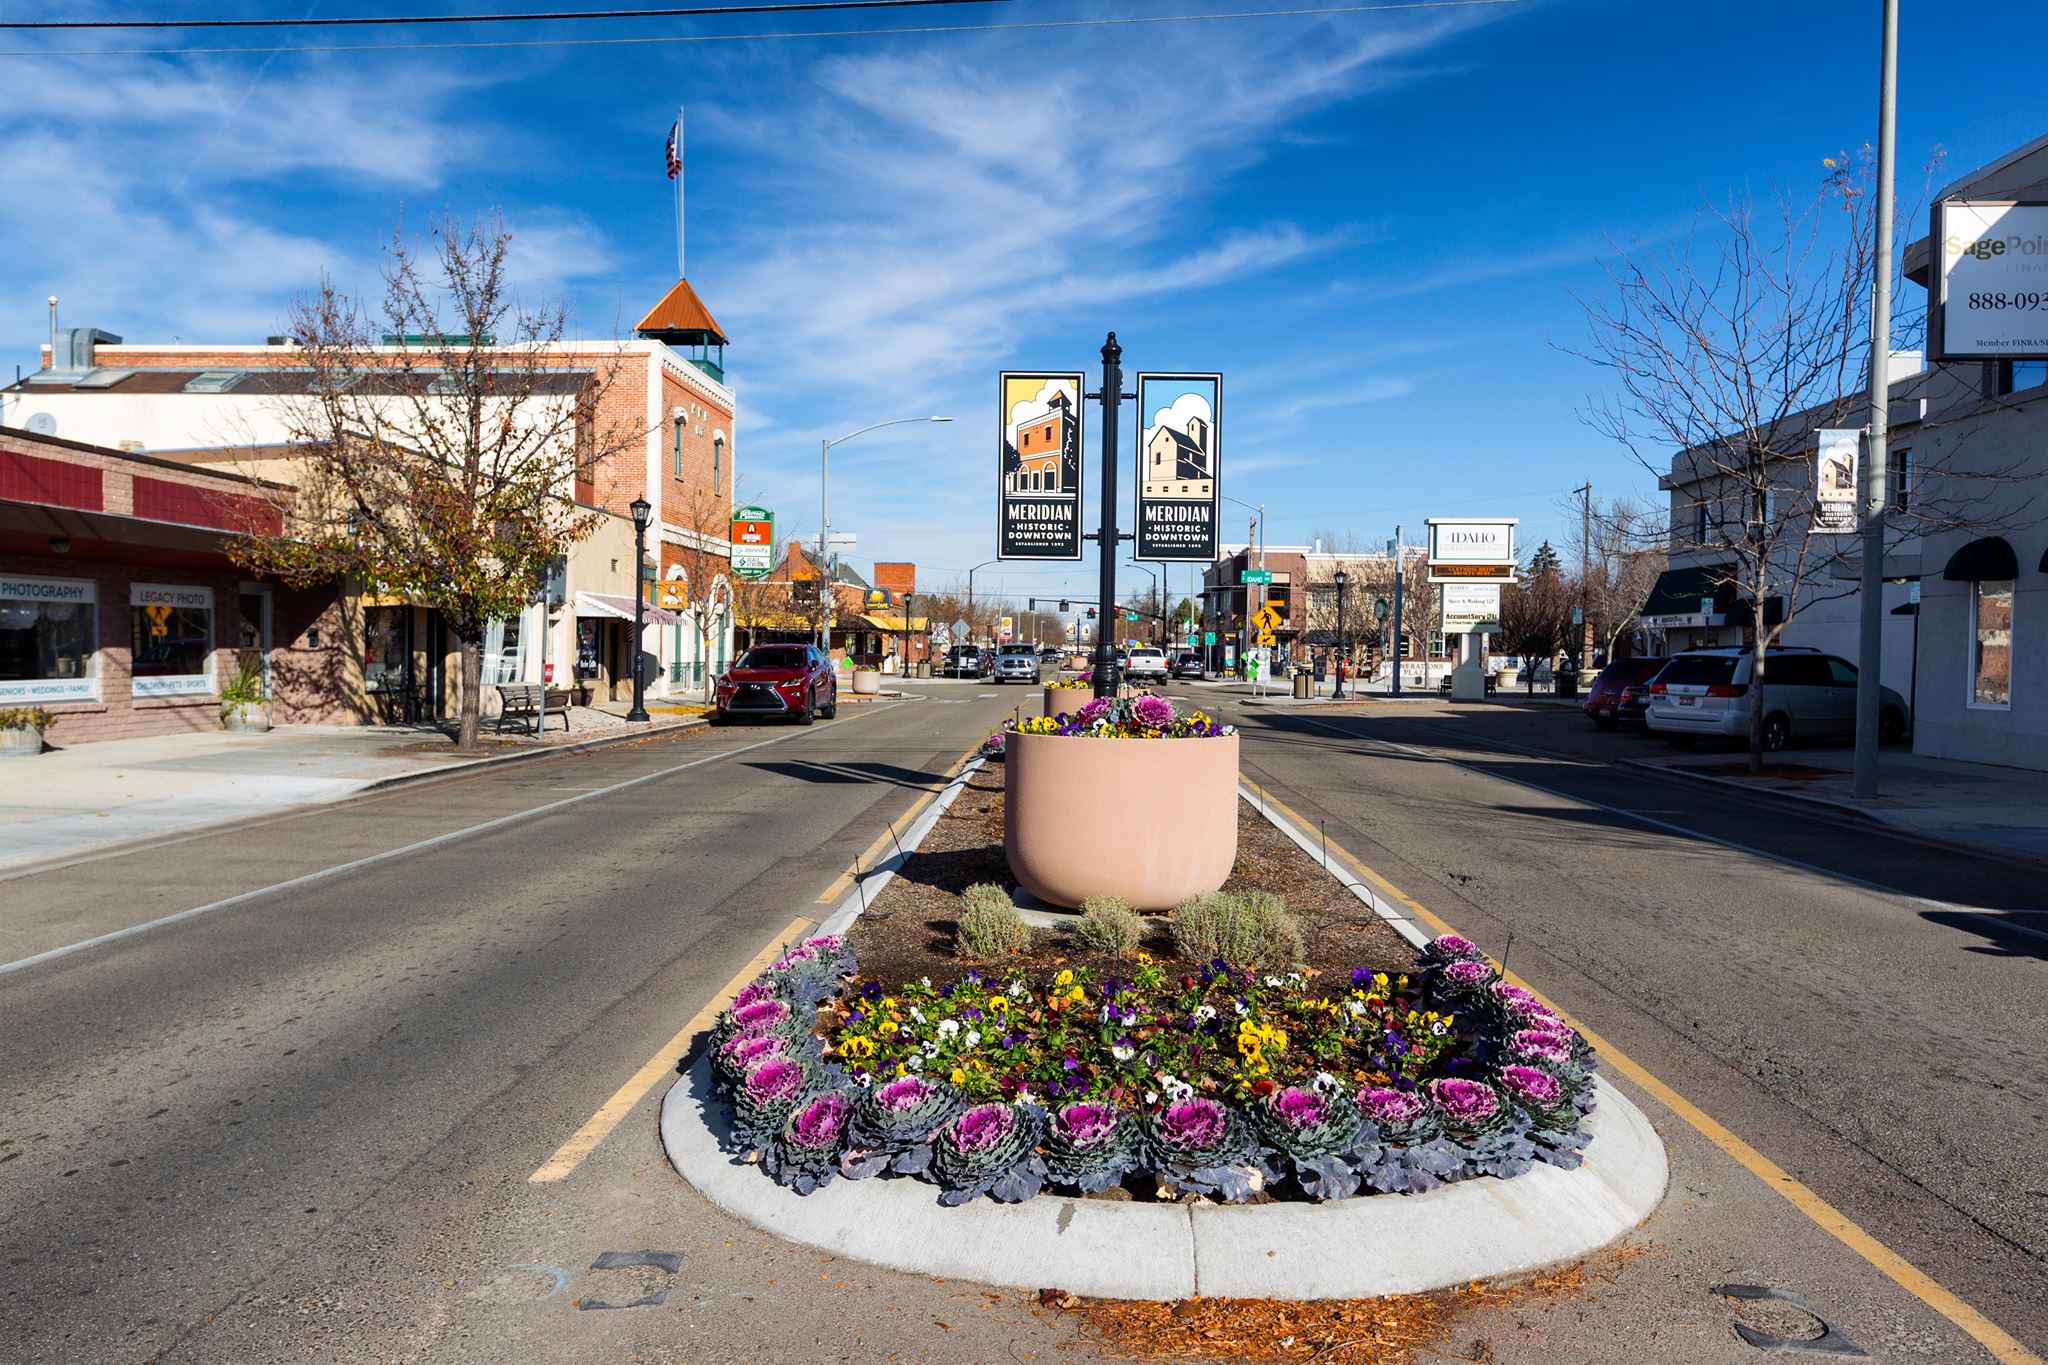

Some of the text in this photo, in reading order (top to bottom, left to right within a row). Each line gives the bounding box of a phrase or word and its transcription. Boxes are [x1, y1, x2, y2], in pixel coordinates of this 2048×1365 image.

[1976, 338, 2010, 347] Member
[1008, 504, 1072, 520] MERIDIAN
[1145, 505, 1209, 522] MERIDIAN
[1016, 523, 1064, 531] HISTORIC
[1008, 532, 1072, 540] DOWNTOWN
[1451, 532, 1496, 543] IDAHO
[2, 583, 84, 599] PHOTOGRAPHY
[140, 591, 205, 604] LEGACY PHOTO
[32, 685, 65, 694] WEDDINGS
